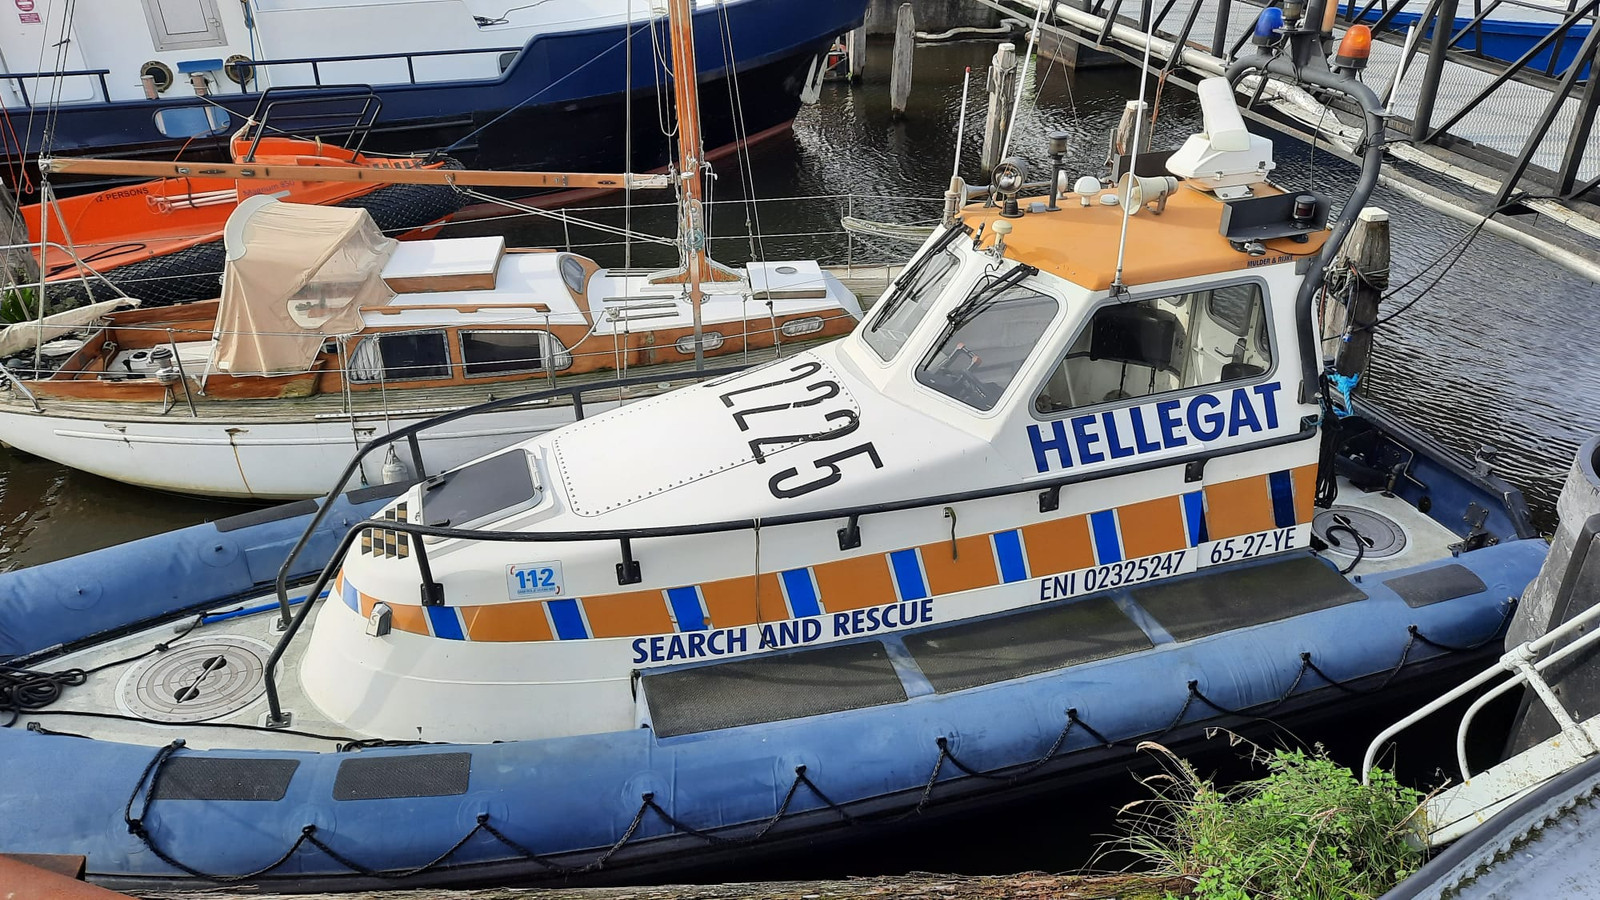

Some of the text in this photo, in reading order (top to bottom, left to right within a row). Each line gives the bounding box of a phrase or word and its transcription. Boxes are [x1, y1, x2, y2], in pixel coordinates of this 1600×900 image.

[105, 187, 149, 201] PERSONS
[1247, 257, 1270, 267] MULDER
[1026, 382, 1282, 473] HELLEGAT
[1210, 527, 1297, 564] 65-27-YE
[1040, 551, 1187, 601] ENI 02325247
[632, 599, 935, 664] SEARCH AND RESCUE
